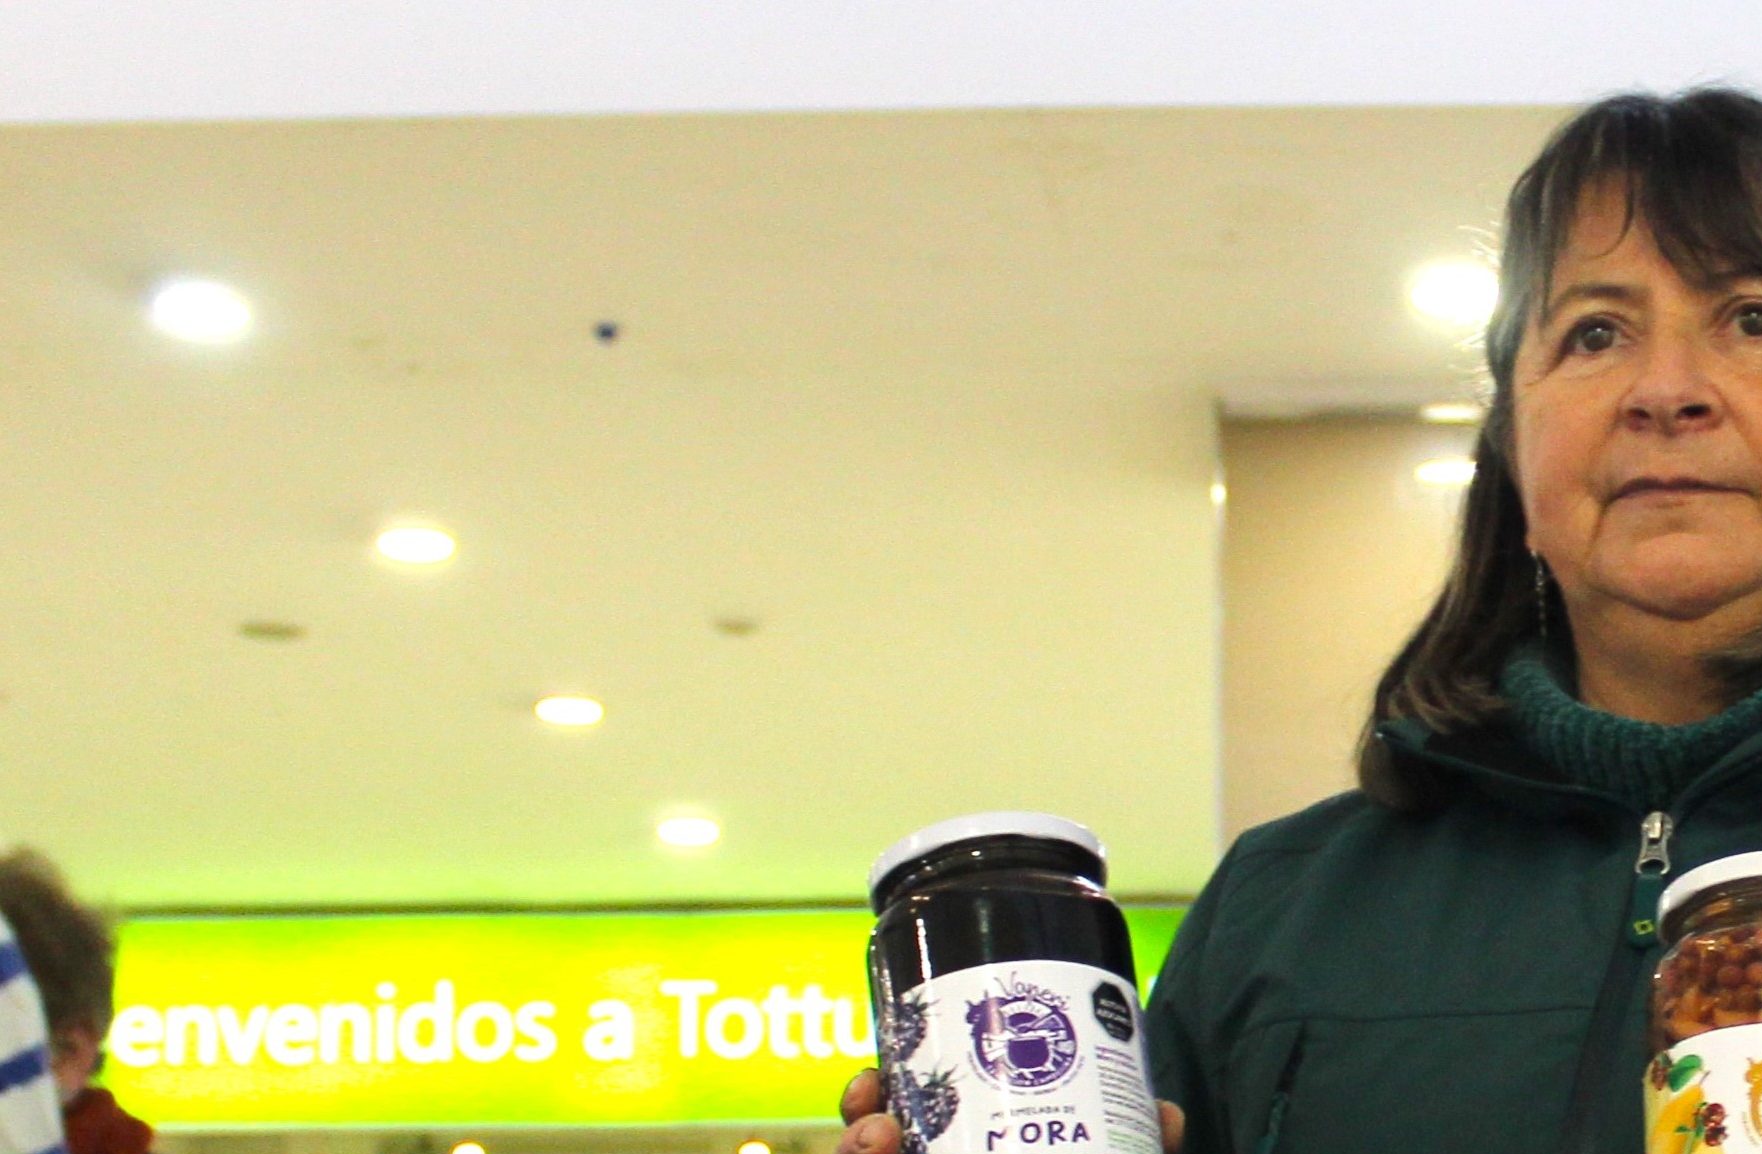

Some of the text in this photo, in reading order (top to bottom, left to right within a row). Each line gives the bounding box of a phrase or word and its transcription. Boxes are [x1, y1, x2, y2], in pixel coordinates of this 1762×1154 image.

[109, 979, 878, 1068] envenidos a Tottu
[987, 1121, 1090, 1151] MORA
